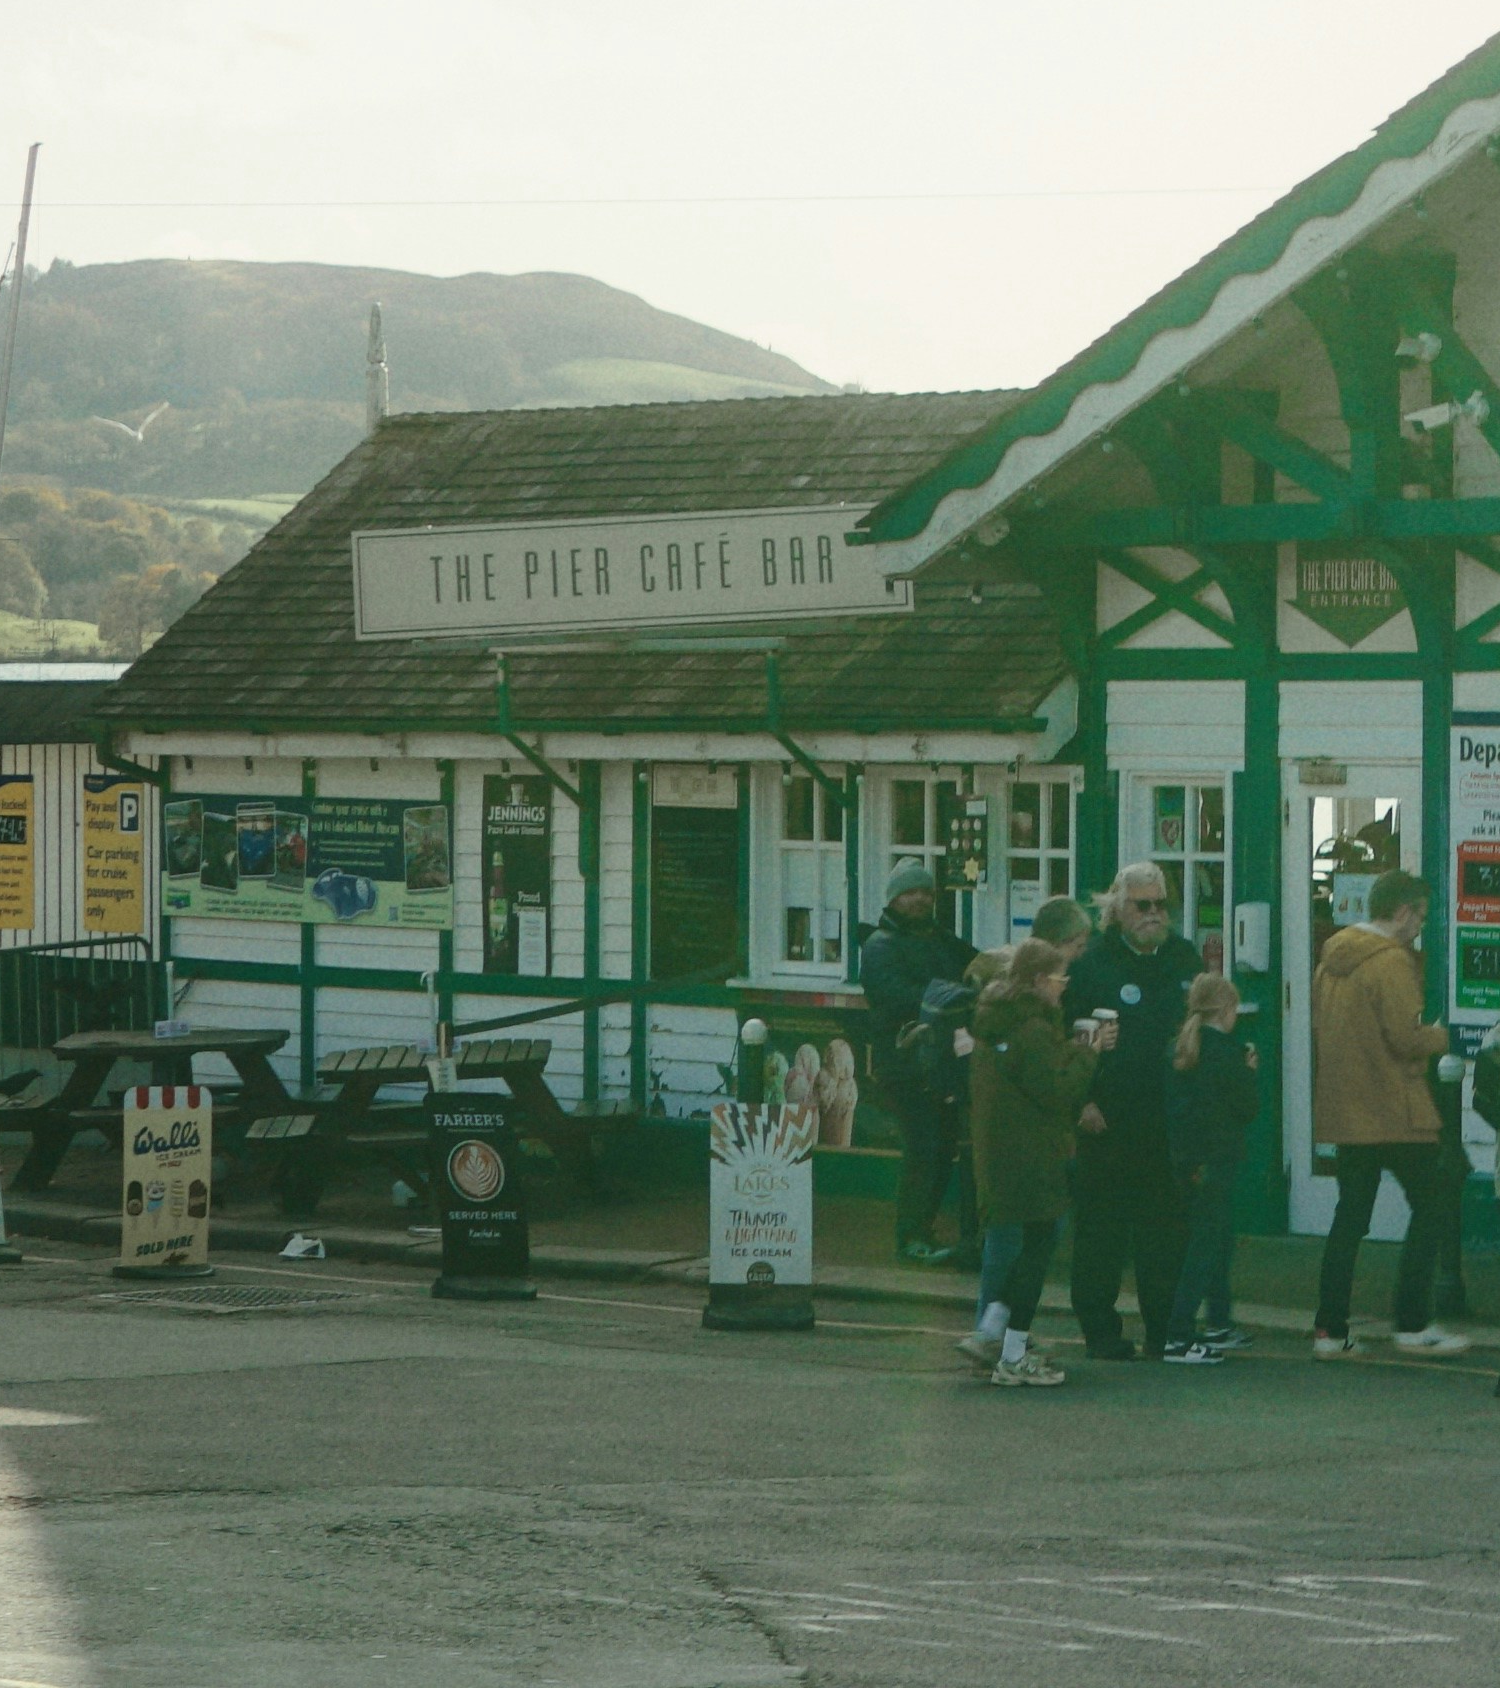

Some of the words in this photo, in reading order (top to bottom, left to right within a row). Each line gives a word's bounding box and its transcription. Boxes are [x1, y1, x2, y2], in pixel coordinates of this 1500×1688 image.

[429, 553, 497, 603] THE
[525, 547, 610, 600] PIER
[640, 532, 732, 593] CAFÉ
[761, 535, 833, 587] BAR
[1302, 561, 1320, 591] THE
[1324, 560, 1348, 591] PIER
[1310, 593, 1392, 607] ENTRANCE
[86, 800, 100, 813] Pay
[102, 800, 117, 812] and
[488, 805, 546, 822] JENNINGS
[88, 819, 115, 832] display
[1472, 824, 1486, 836] ask
[1488, 825, 1498, 836] at
[87, 846, 103, 859] Car
[105, 847, 139, 864] parking
[86, 865, 99, 878] for
[101, 867, 128, 880] cruise
[86, 887, 135, 902] passengers
[86, 905, 106, 920] only
[433, 1113, 505, 1127] FARRER'S
[133, 1120, 201, 1155] Wall's
[734, 1174, 790, 1195] LAKES
[449, 1211, 488, 1220] SERVED
[491, 1211, 517, 1220] HERE
[136, 1240, 164, 1257] SOLD
[166, 1234, 195, 1251] HERE
[731, 1248, 748, 1257] ICE
[752, 1249, 793, 1257] CREAM
